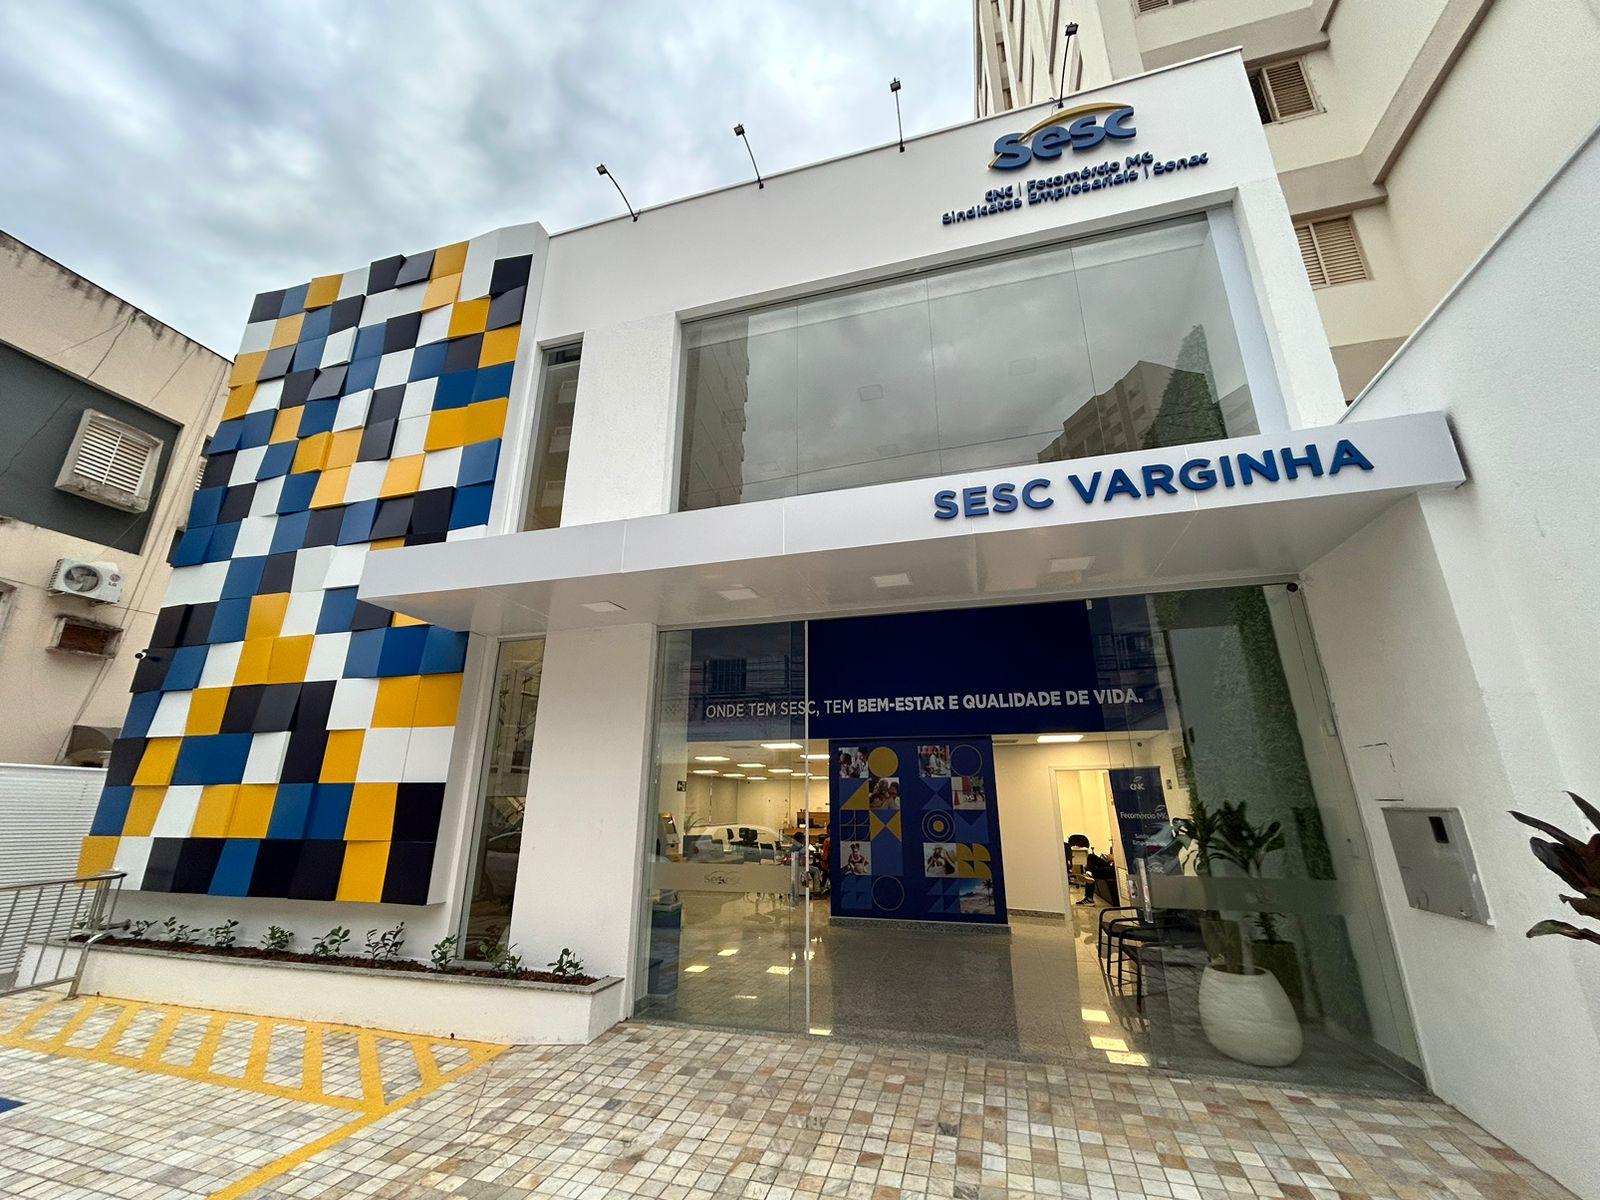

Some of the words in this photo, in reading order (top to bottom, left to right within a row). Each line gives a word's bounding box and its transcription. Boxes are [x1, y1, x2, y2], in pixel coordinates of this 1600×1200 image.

[942, 198, 1022, 225] Sindicatos
[1028, 170, 1138, 205] Empresariais
[1153, 152, 1209, 175] Senac
[985, 185, 1013, 202] CNC
[1027, 161, 1121, 192] Fecomércio
[1126, 151, 1154, 169] MG
[934, 478, 1055, 519] SESC
[1067, 439, 1375, 504] VARGINHA
[706, 703, 745, 718] ONDE
[749, 702, 777, 716] TEM
[780, 700, 820, 717] SESC,
[824, 699, 854, 714] TEM
[857, 696, 945, 713] BEM-ESTAR
[949, 695, 959, 710] E
[962, 690, 1062, 709] QUALIDADE
[1065, 689, 1090, 706] DE
[1093, 688, 1145, 705] VIDA.
